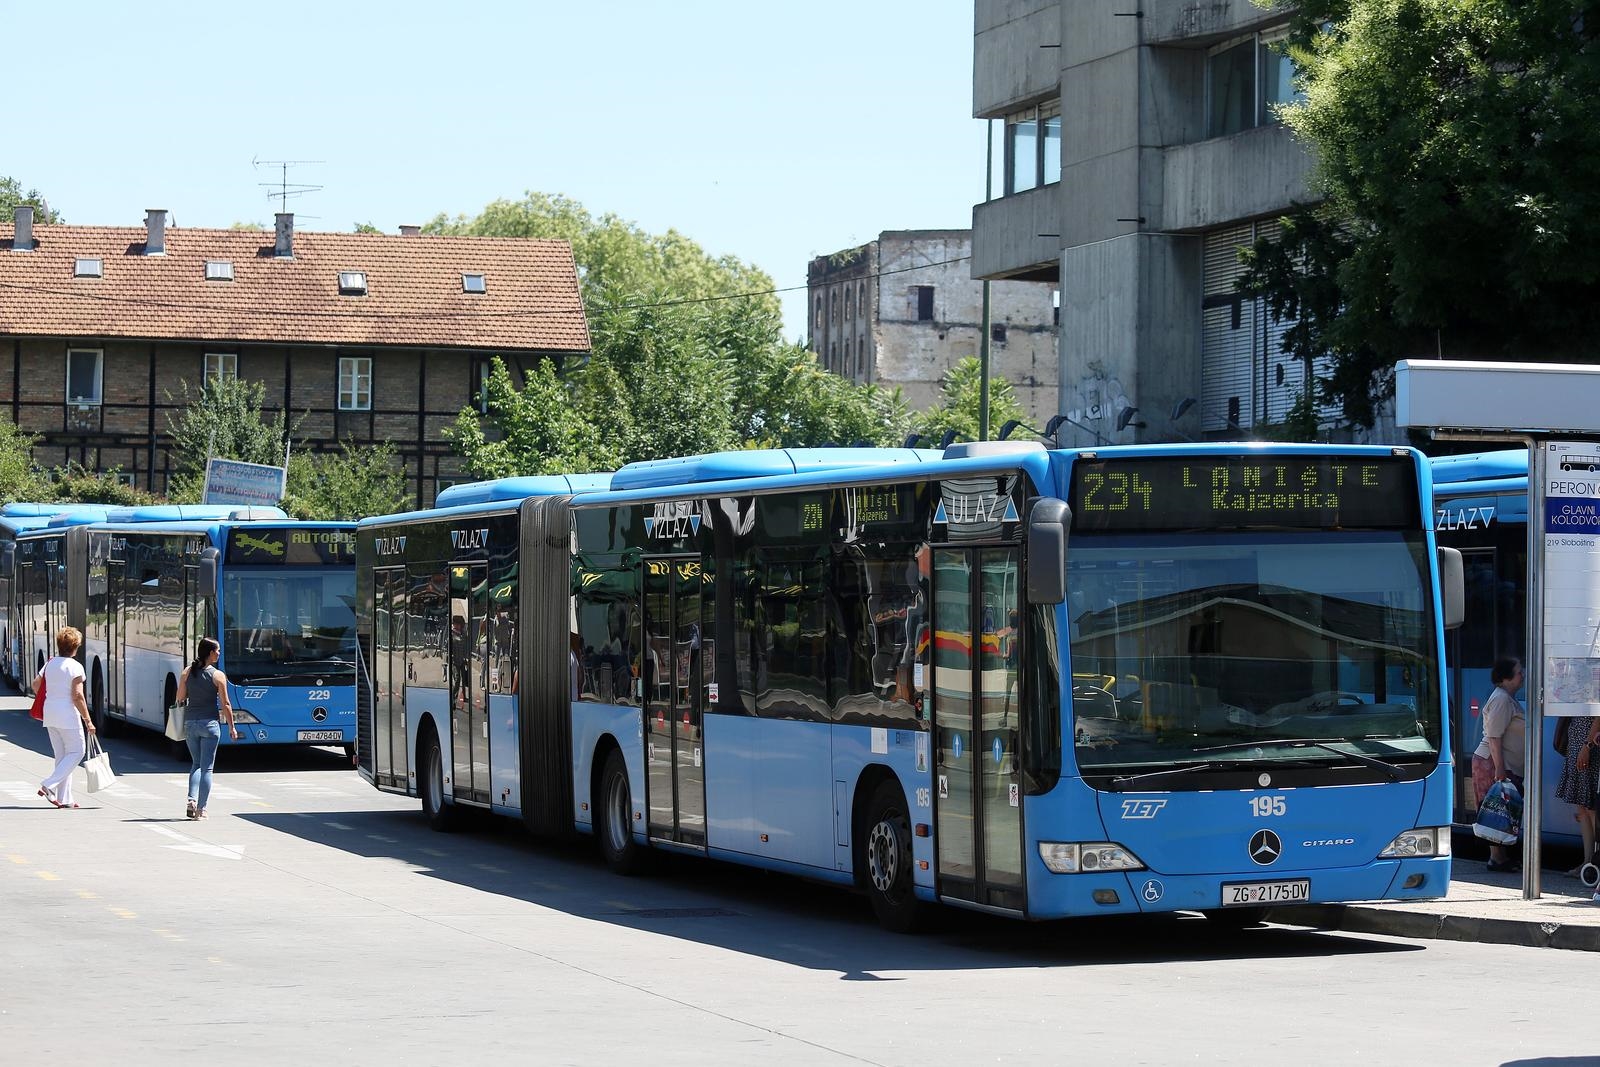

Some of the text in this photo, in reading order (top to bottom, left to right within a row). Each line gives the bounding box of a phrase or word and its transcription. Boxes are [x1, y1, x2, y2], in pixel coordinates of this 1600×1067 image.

[1084, 473, 1153, 511] 234
[1550, 481, 1596, 495] PERON
[952, 494, 999, 523] ULAZ
[1212, 488, 1339, 511] Kajzerica
[1436, 507, 1478, 531] ZLAZ
[1561, 504, 1596, 515] GLAVNI
[655, 515, 689, 539] IZLAZ
[381, 537, 400, 555] IZLAZ
[458, 529, 481, 549] IZLAZ
[244, 688, 268, 699] ZET
[308, 690, 331, 700] 229
[302, 731, 312, 740] ZG
[915, 788, 930, 807] 195
[1249, 795, 1287, 817] 195
[1121, 799, 1168, 819] ZET
[1302, 838, 1355, 847] CITARO
[1232, 887, 1249, 903] ZG
